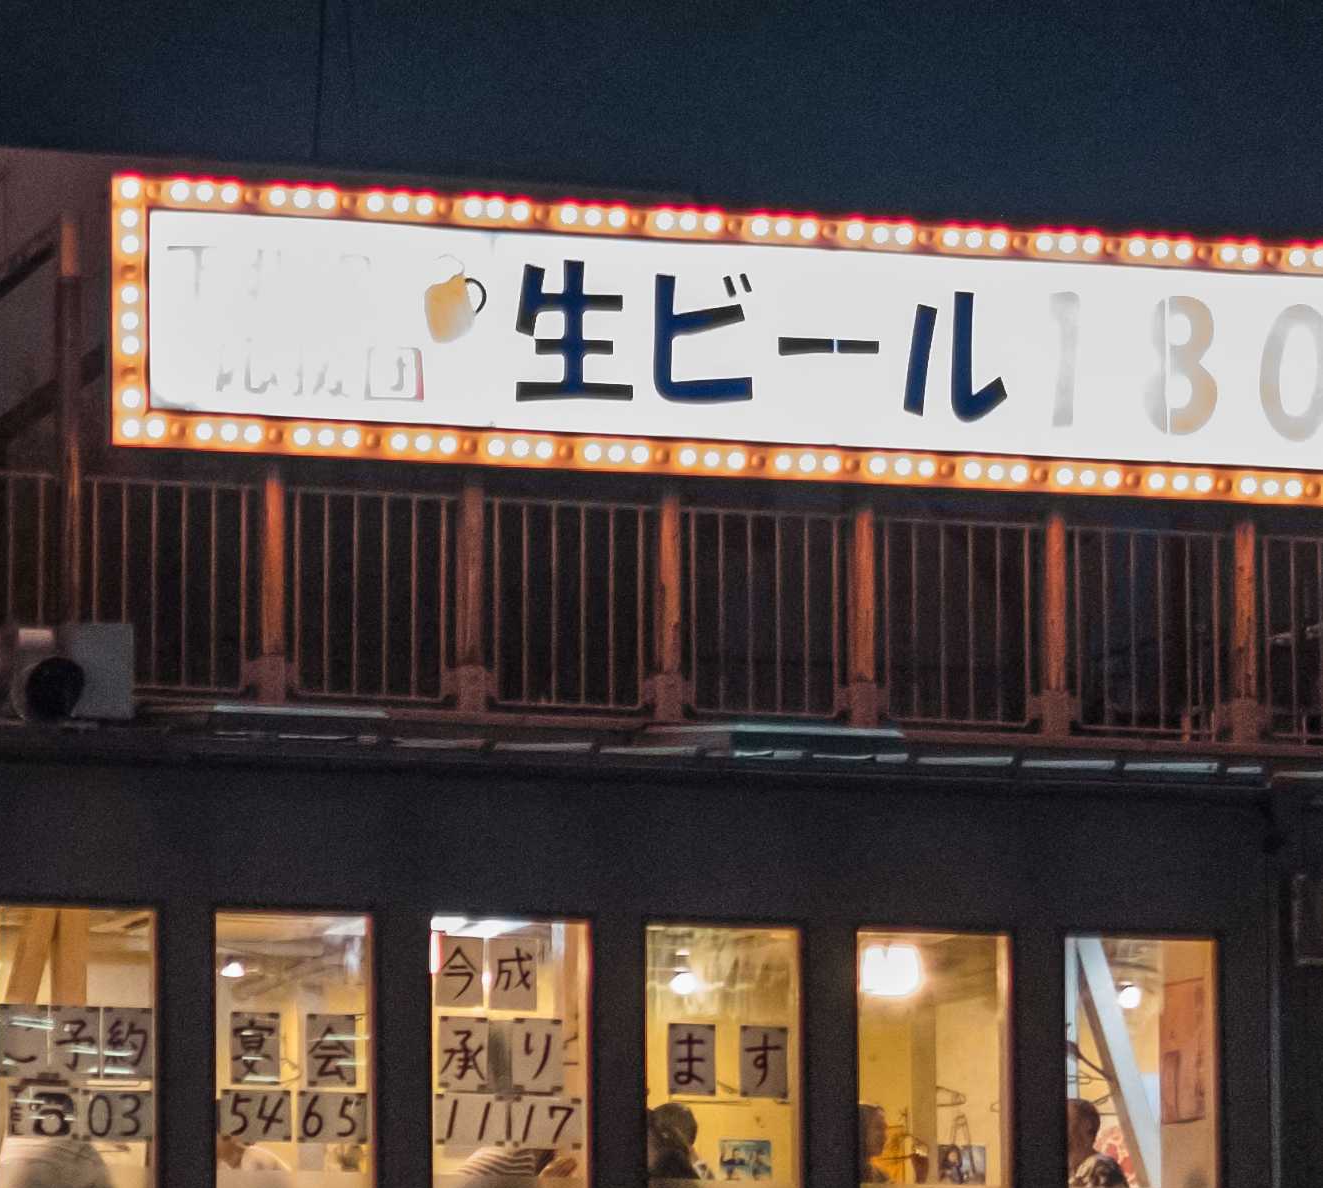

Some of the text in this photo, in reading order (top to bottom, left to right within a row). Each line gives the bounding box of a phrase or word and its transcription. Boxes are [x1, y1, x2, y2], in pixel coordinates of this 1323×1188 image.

[516, 259, 1008, 422] 生ビール
[442, 947, 533, 1000] 今成
[231, 1020, 353, 1079] 宴会
[441, 1031, 550, 1080] 承り
[673, 1032, 781, 1085] ます
[88, 1095, 142, 1138] 03
[231, 1097, 357, 1138] 5465
